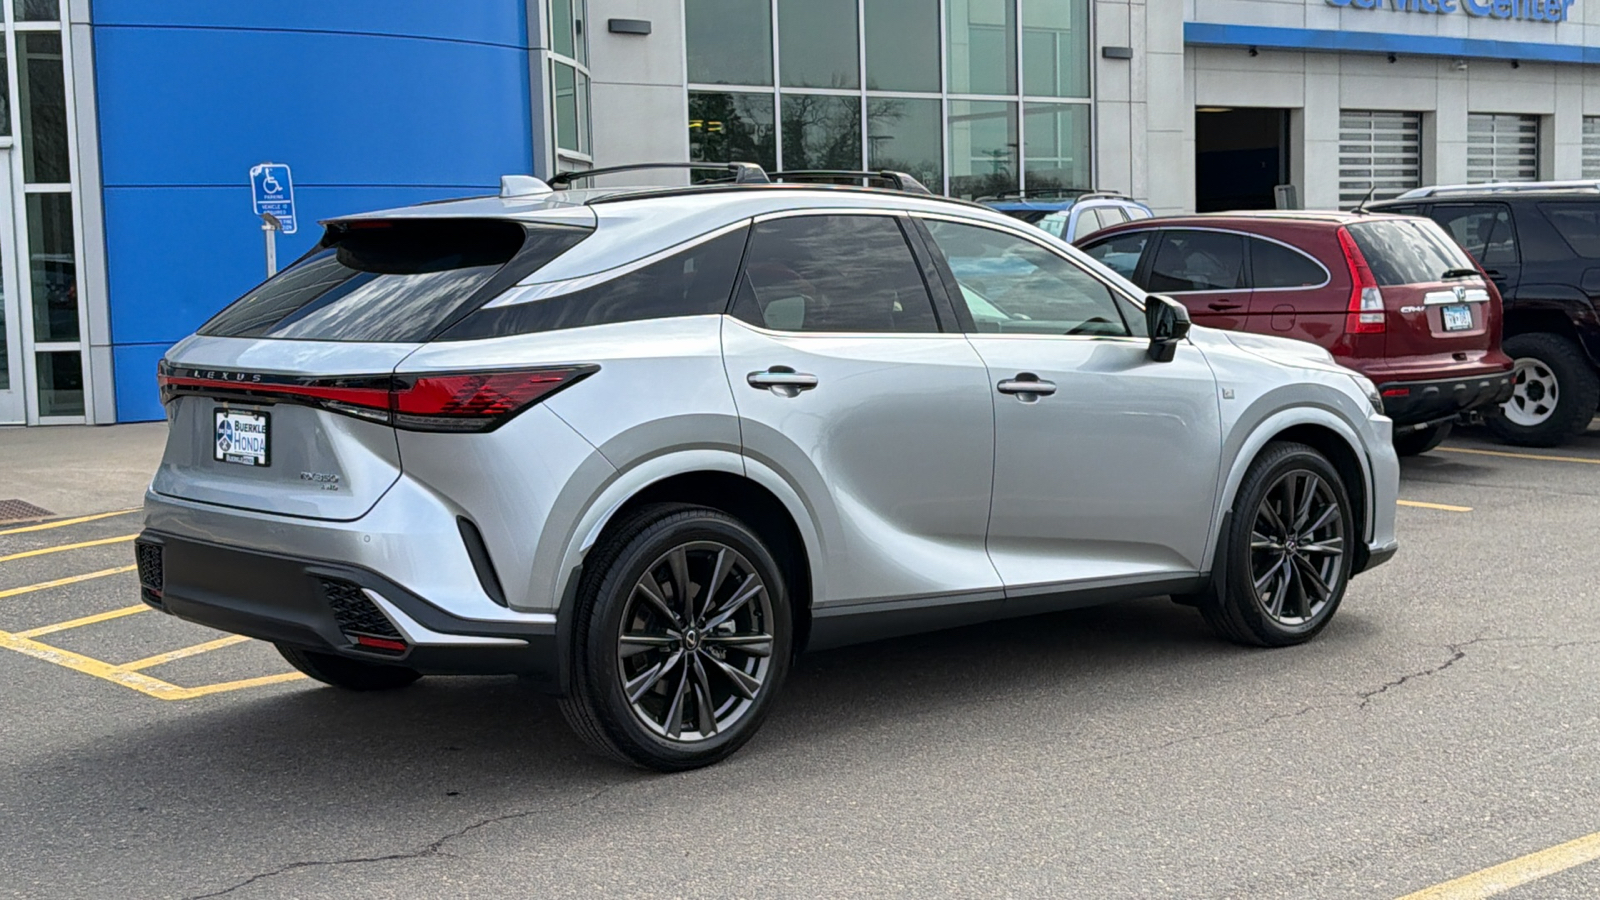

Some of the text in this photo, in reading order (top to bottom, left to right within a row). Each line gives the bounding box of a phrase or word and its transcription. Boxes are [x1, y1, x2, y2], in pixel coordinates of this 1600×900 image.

[193, 370, 262, 382] LEXUS
[234, 420, 266, 434] BUERKLE
[234, 433, 265, 452] HONDA
